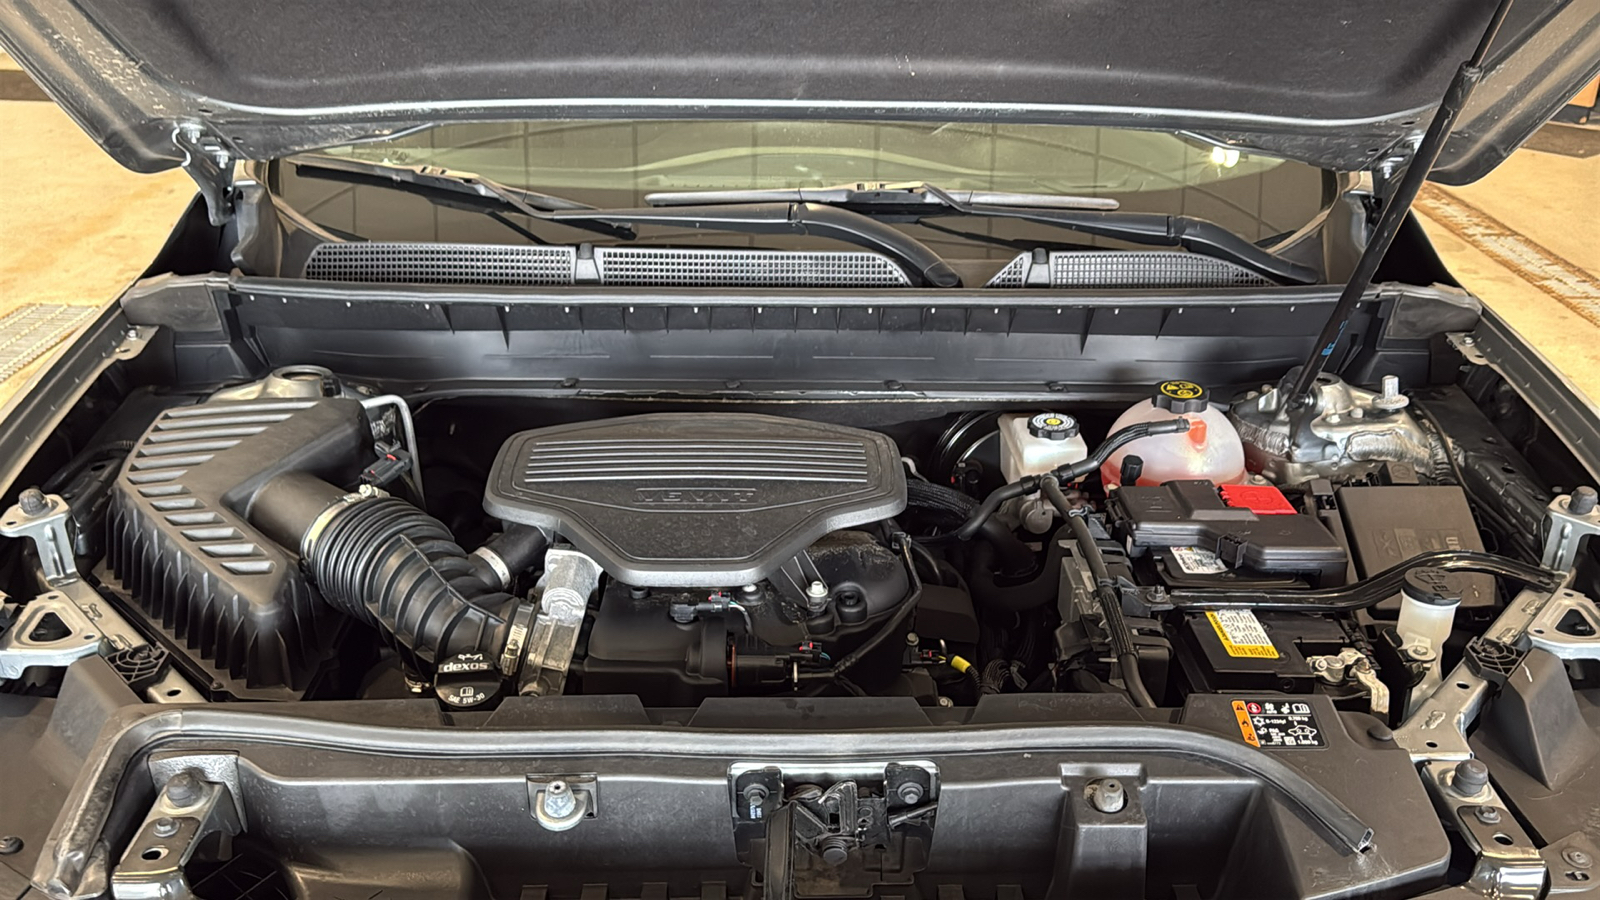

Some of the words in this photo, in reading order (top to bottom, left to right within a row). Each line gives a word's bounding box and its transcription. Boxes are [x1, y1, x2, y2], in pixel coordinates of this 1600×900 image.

[443, 662, 488, 672] dexos
[448, 694, 461, 704] SAE
[462, 692, 486, 704] 5W-30
